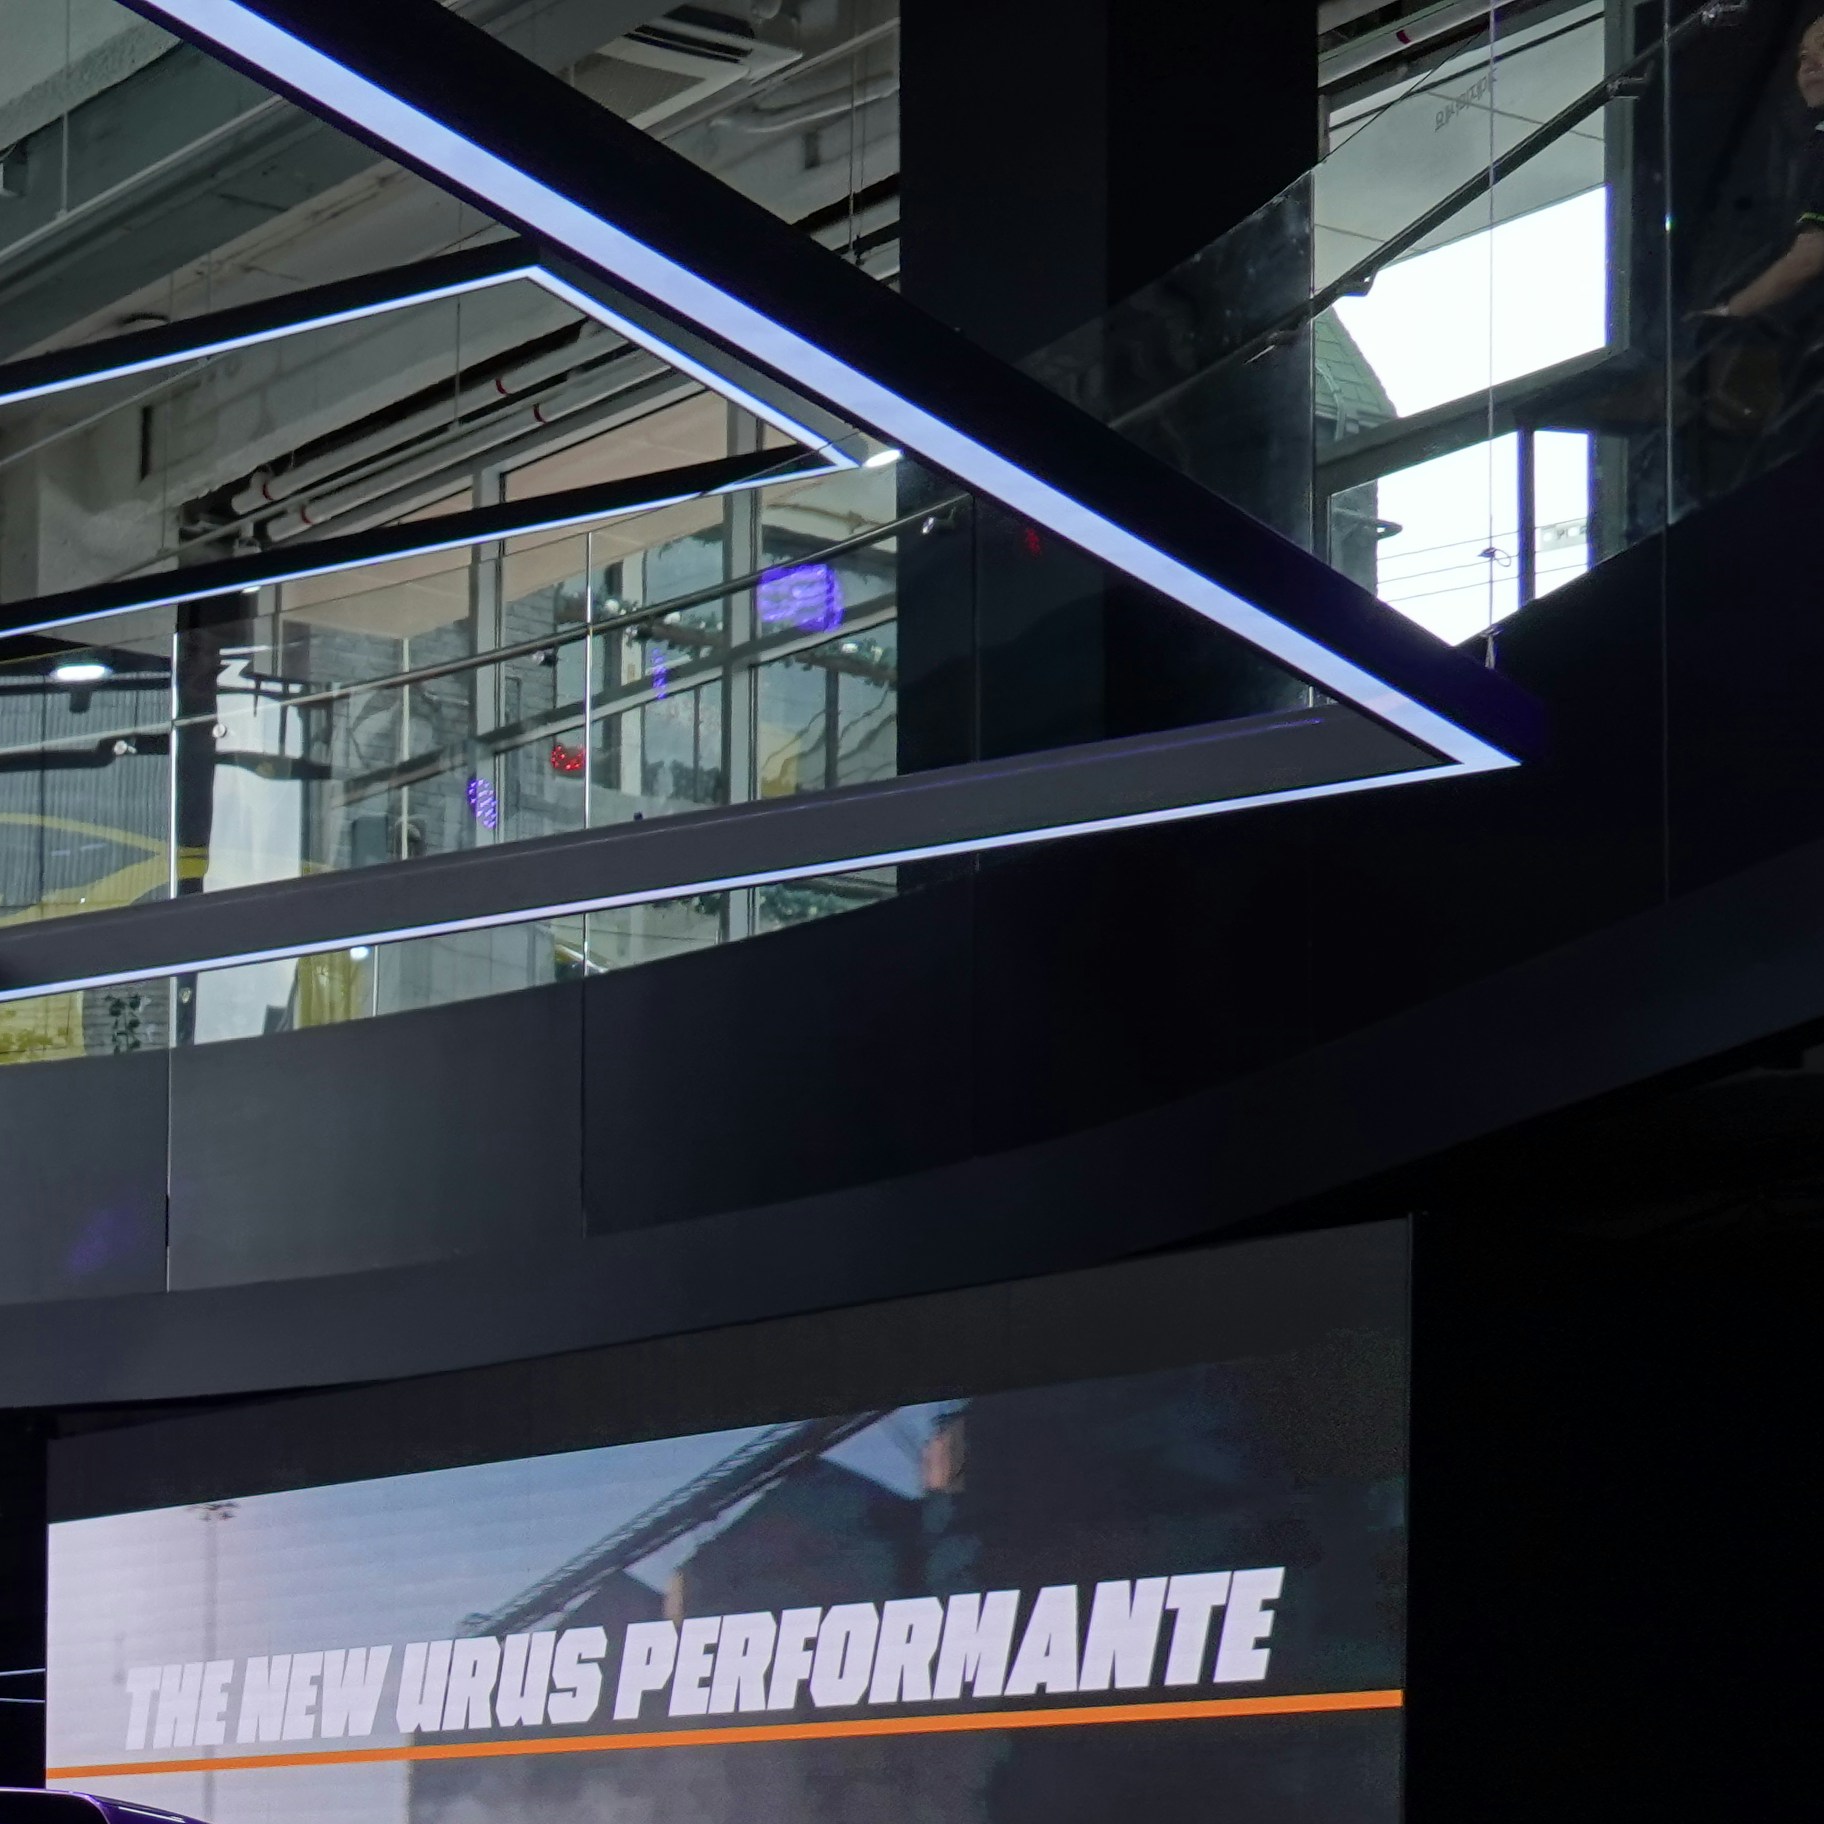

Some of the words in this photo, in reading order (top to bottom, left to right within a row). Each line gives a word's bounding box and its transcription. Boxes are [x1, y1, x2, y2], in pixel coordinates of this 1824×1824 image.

[125, 1660, 234, 1751] THE
[236, 1645, 393, 1744] NEW
[396, 1626, 607, 1734] URUS
[613, 1566, 1286, 1721] PERFORMANTE
